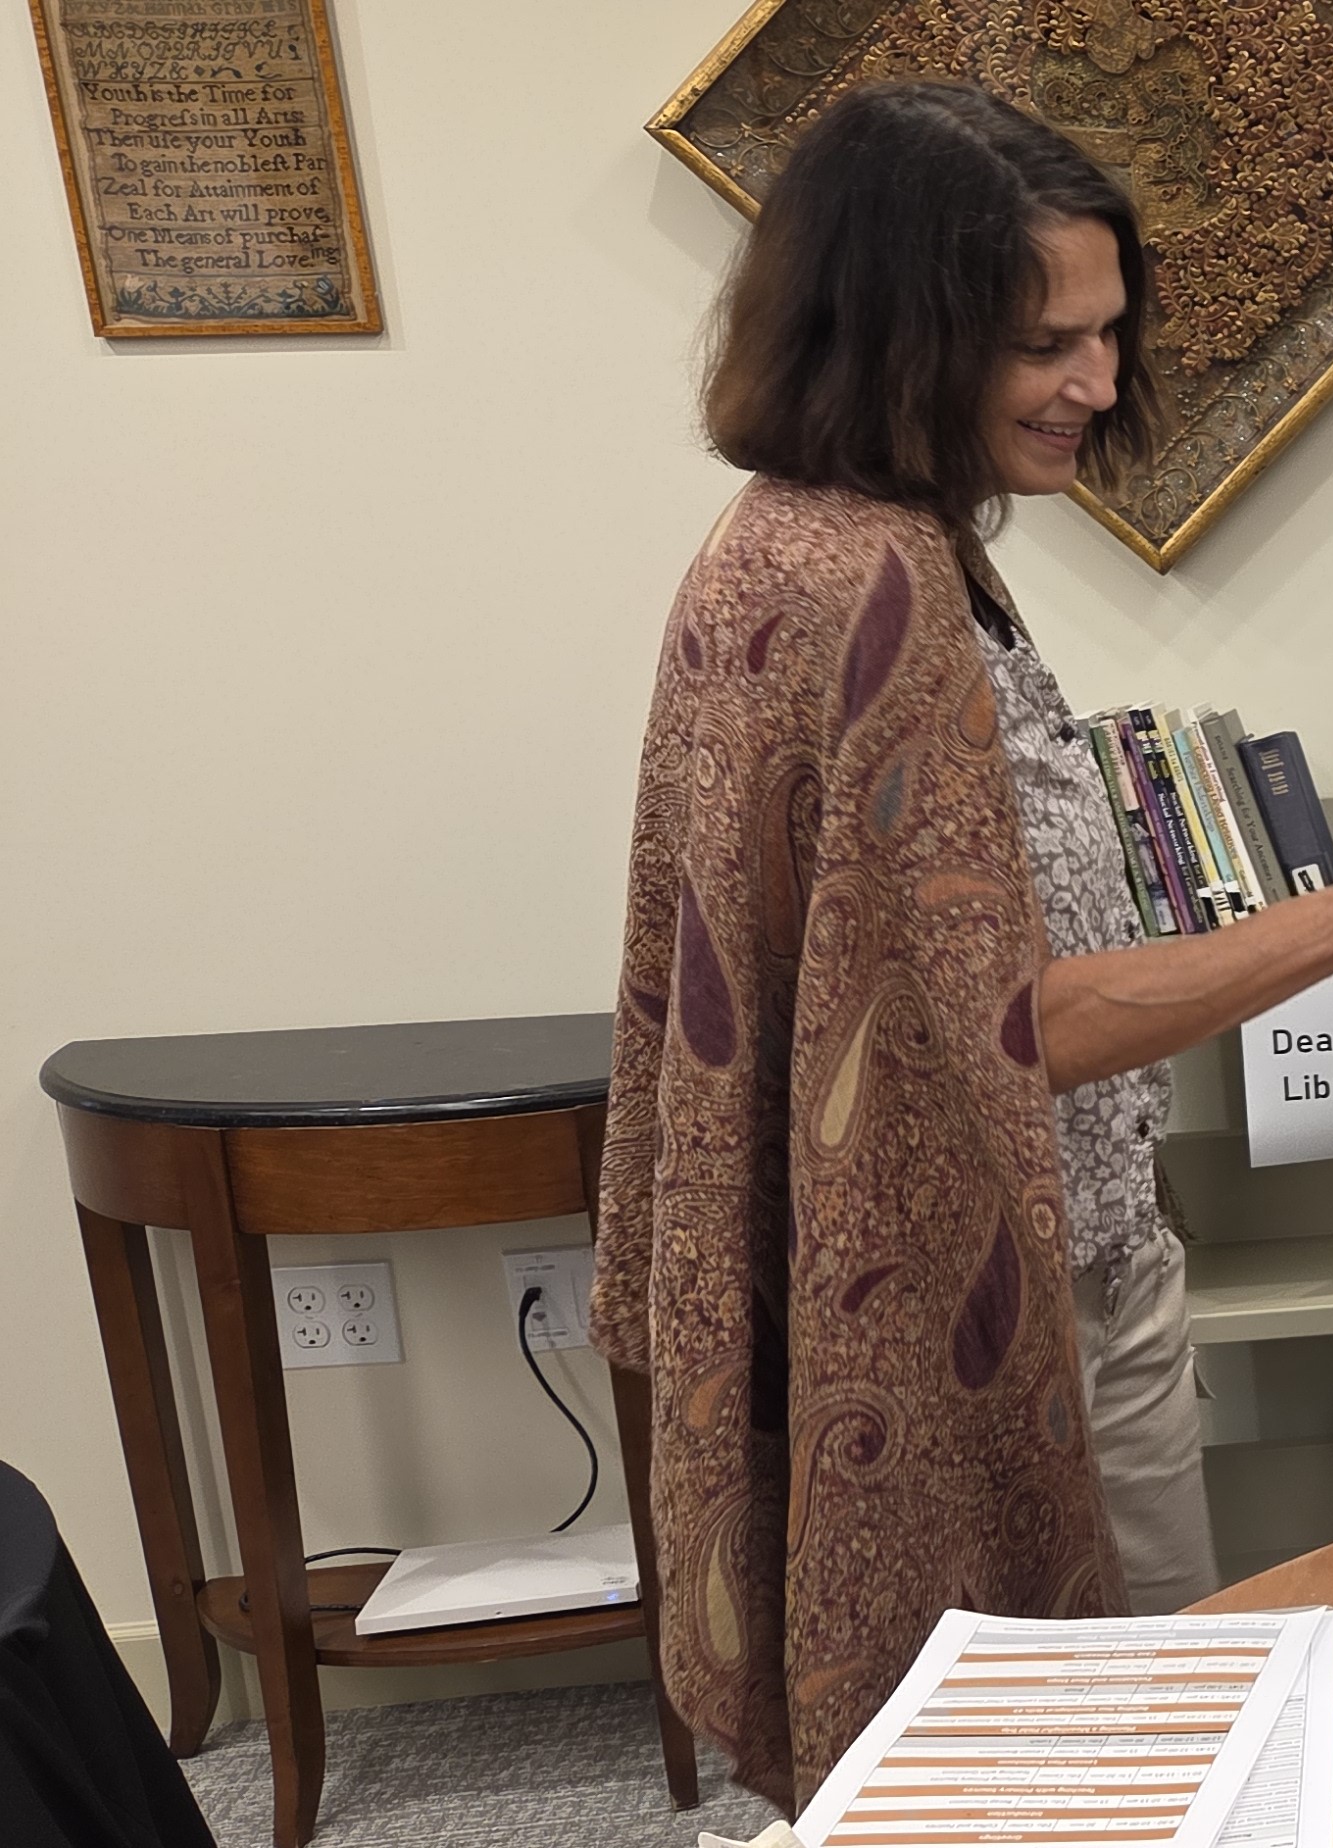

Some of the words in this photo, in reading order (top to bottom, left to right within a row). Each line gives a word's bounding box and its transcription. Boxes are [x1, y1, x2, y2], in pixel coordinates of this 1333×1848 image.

[262, 83, 296, 101] for
[223, 107, 251, 126] all
[185, 135, 237, 153] your
[241, 127, 307, 148] Youth
[99, 177, 148, 197] Zeal
[153, 178, 182, 198] for
[189, 179, 294, 199] Attainment
[296, 176, 320, 195] of
[127, 202, 178, 222] Each
[183, 203, 216, 222] Art
[220, 203, 260, 222] will
[106, 225, 148, 244] One
[213, 227, 239, 246] of
[135, 248, 178, 268] The
[181, 251, 251, 274] general
[1223, 766, 1247, 807] Searching
[1245, 820, 1260, 843] Your
[1253, 842, 1275, 882] Ancestors
